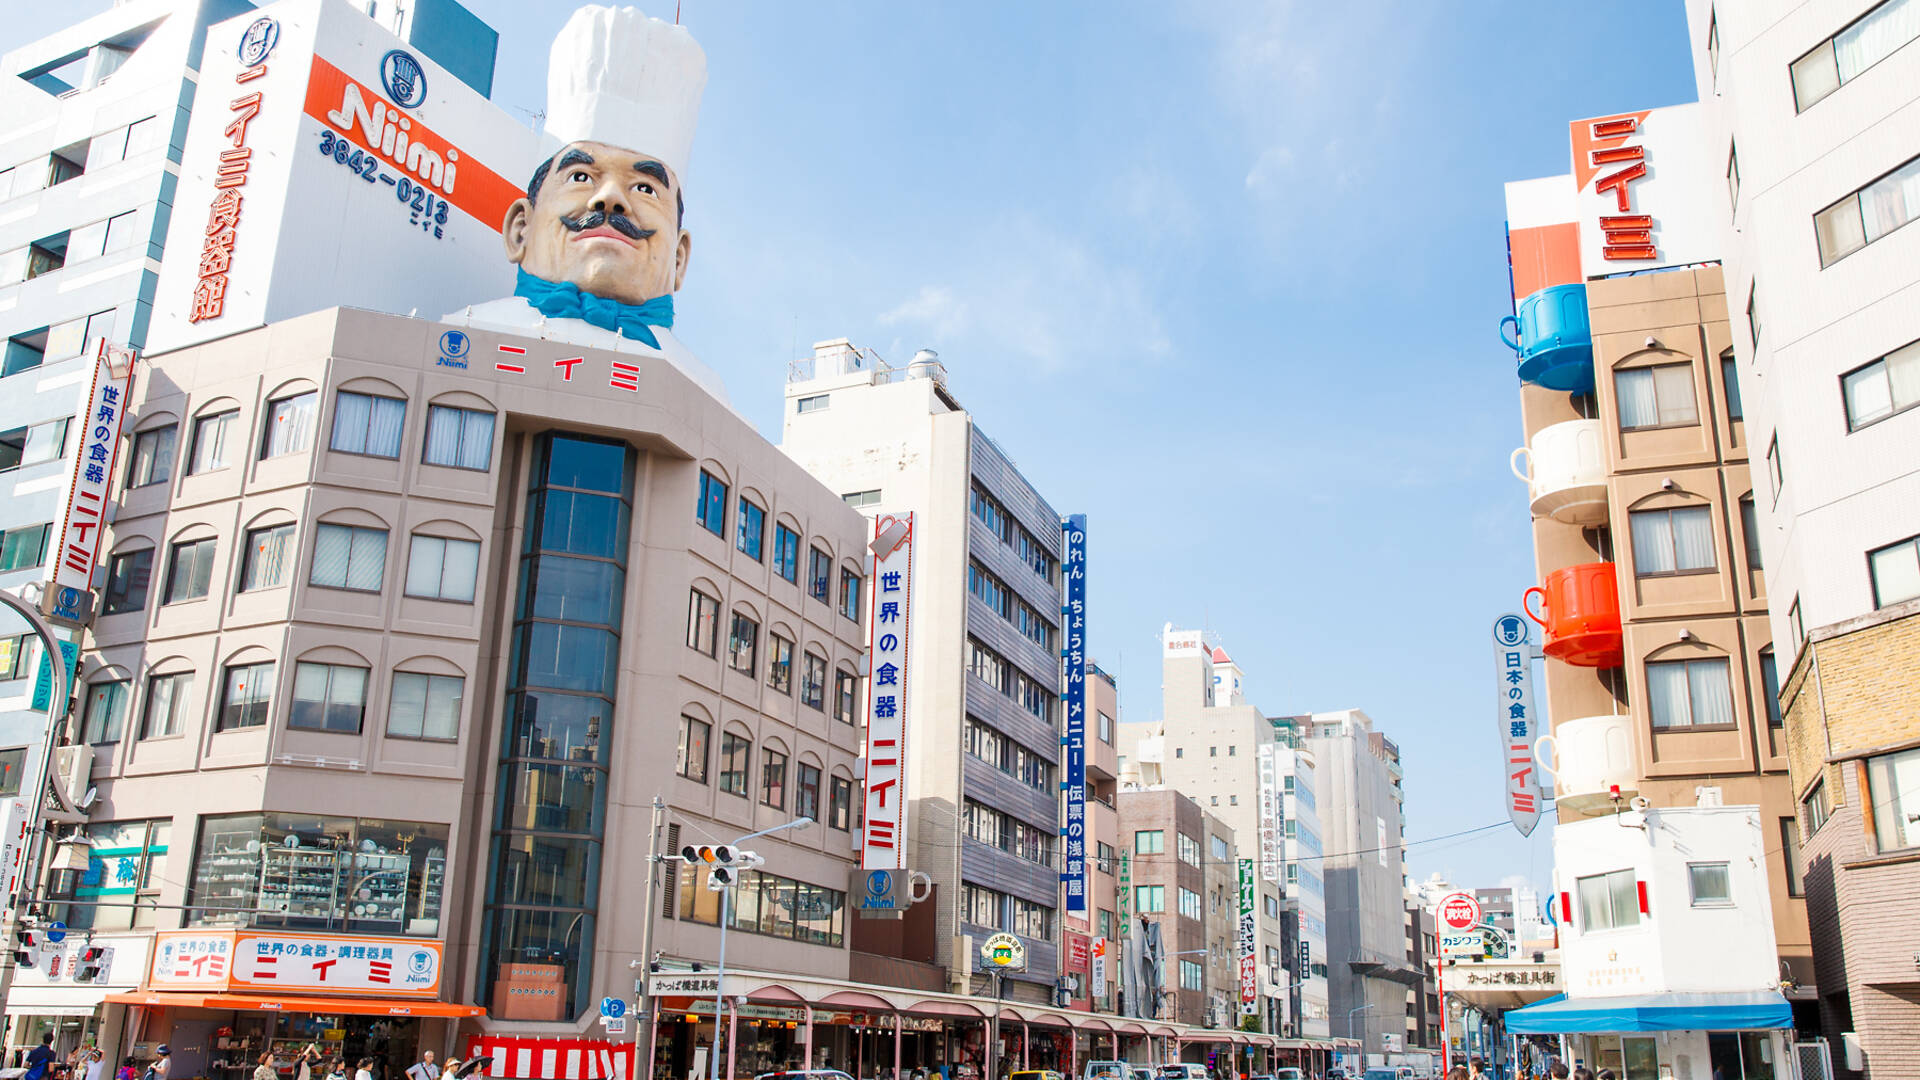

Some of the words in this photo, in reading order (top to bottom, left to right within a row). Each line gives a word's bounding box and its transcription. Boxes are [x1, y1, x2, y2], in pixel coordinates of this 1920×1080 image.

[327, 83, 458, 194] Niimi
[188, 64, 267, 324] ニイミ食器館
[320, 130, 449, 225] 3842-0213
[1592, 118, 1657, 261] ニイミ
[436, 357, 468, 369] Niimi
[495, 344, 640, 392] ニイミ
[85, 385, 119, 484] 世界の食器
[66, 491, 101, 574] ニイミ
[52, 605, 80, 620] Niimi
[875, 571, 901, 718] 世界の食器
[1505, 652, 1528, 738] 日本の食器
[868, 740, 897, 848] ニイミ
[1510, 744, 1535, 813] ニイミ
[861, 896, 895, 909] Niimi
[1446, 907, 1472, 920] 消火栓
[175, 955, 225, 977] ニイミ
[253, 956, 392, 984] ニイミ
[257, 942, 393, 960] 世界の食器・調理器具
[1443, 936, 1481, 946] カジワラ
[406, 974, 430, 984] Niimi
